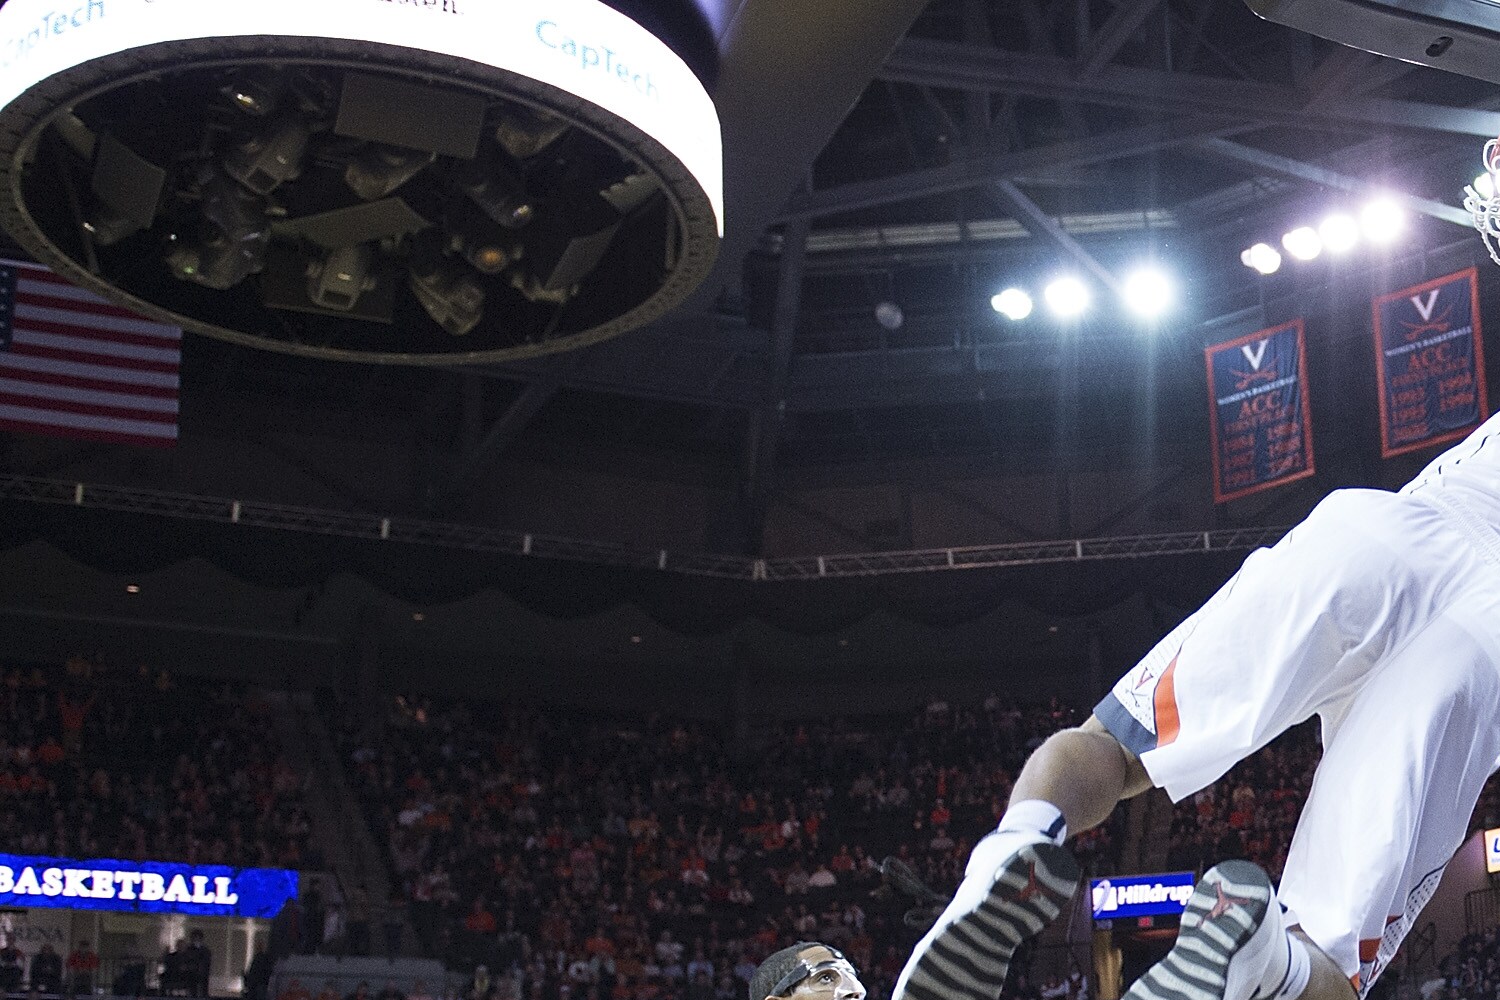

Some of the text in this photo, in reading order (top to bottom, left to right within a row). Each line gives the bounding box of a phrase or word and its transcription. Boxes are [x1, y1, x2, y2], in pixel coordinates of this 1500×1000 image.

[534, 20, 661, 100] CapTech
[1408, 343, 1452, 372] ACC
[1238, 391, 1281, 420] ACC
[1117, 883, 1194, 906] Hilldrup
